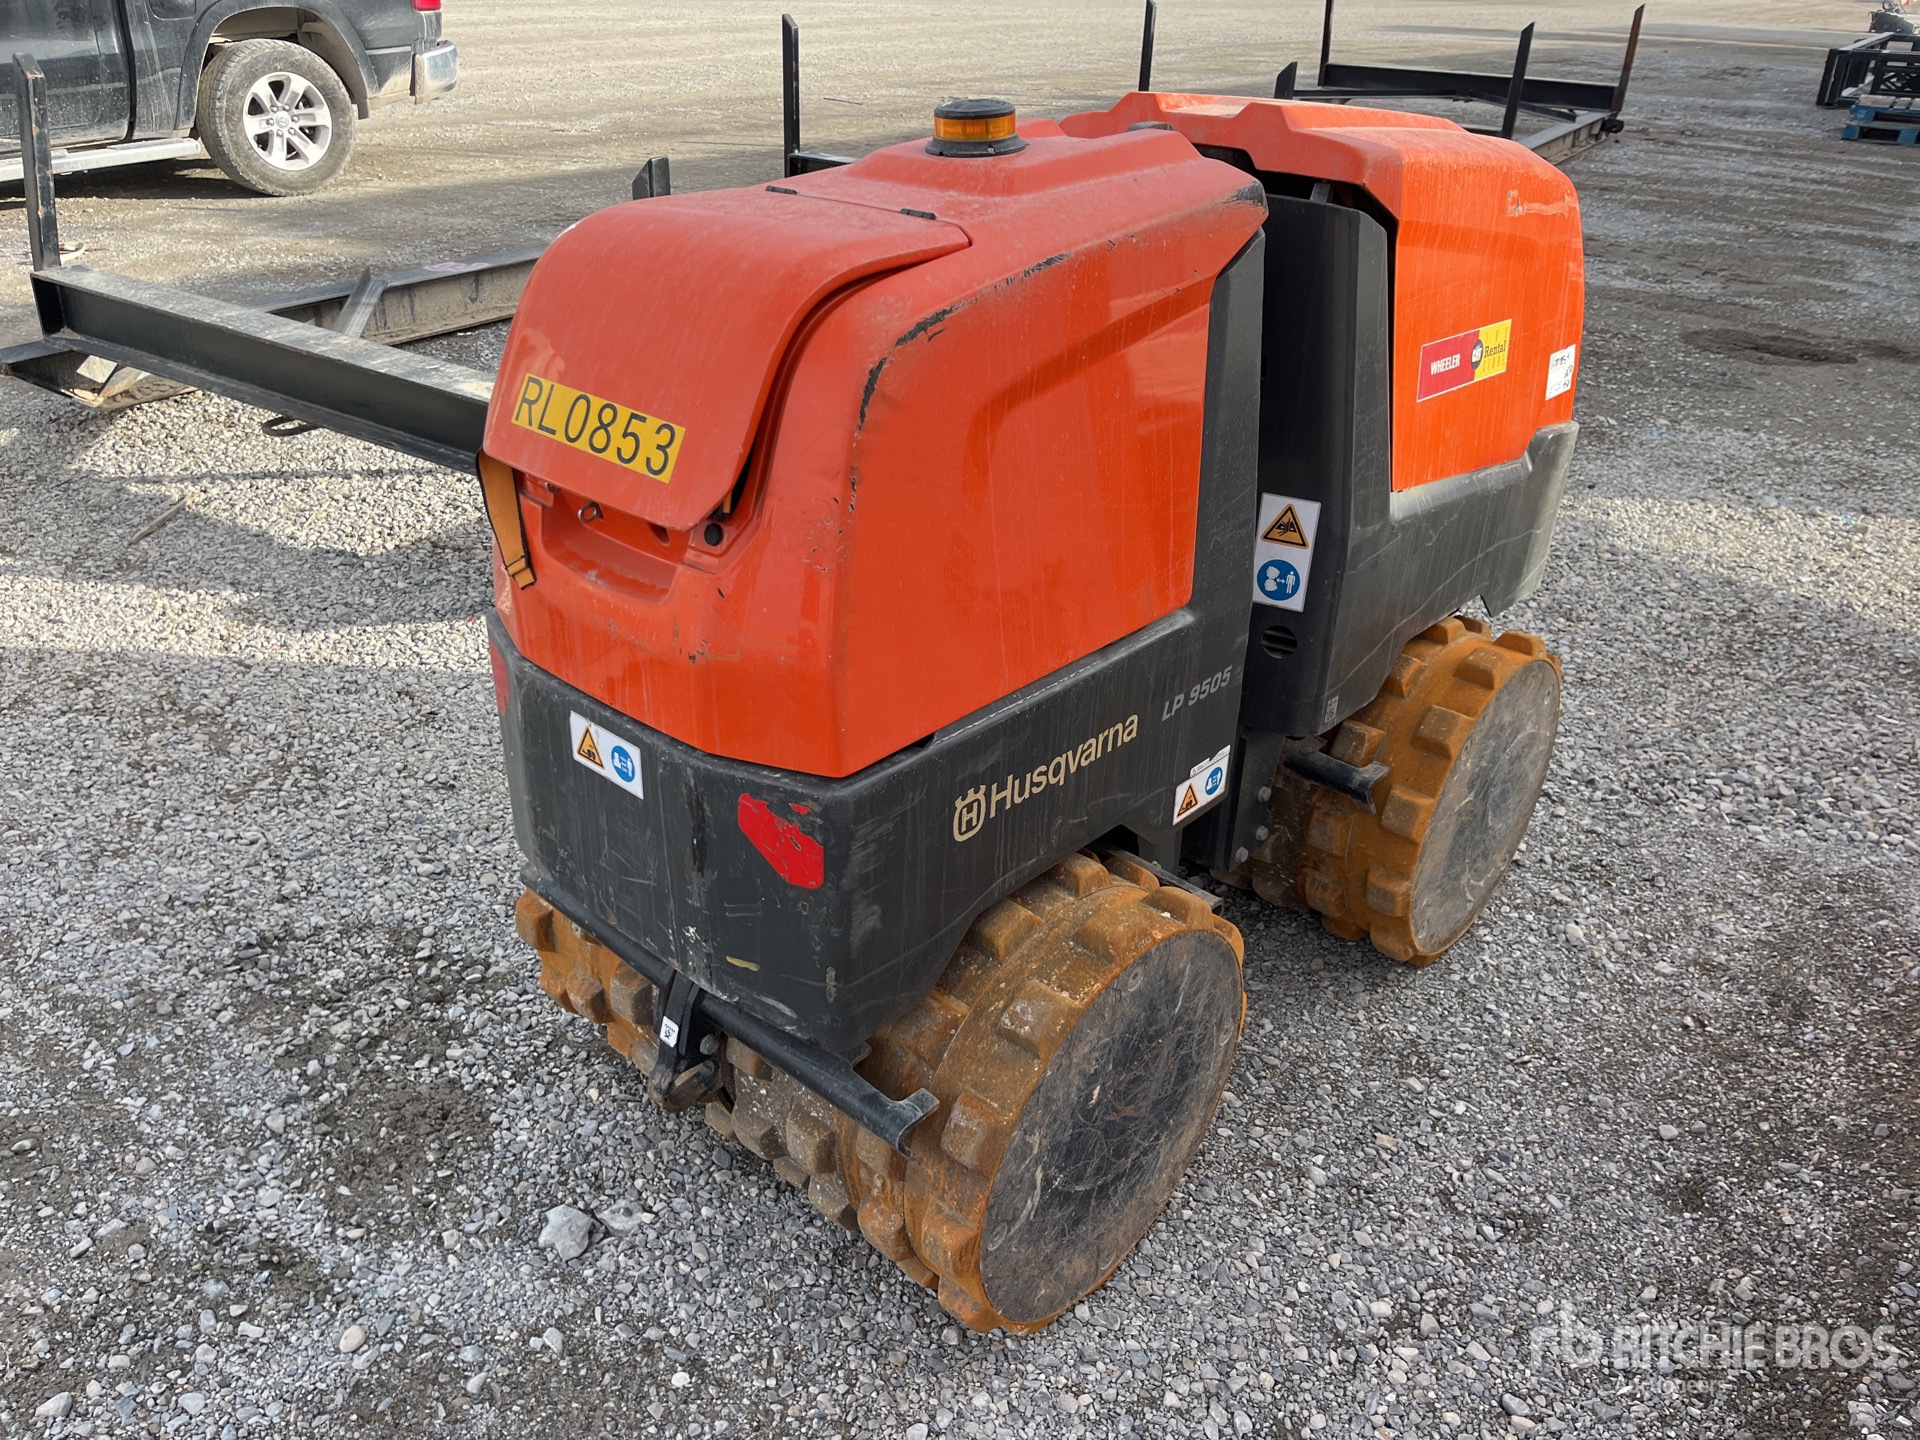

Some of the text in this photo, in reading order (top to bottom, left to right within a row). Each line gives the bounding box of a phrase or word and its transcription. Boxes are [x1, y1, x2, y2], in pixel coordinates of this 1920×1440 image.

[1430, 354, 1461, 376] WHEELER
[1484, 340, 1507, 358] Rental
[515, 376, 676, 476] RL0853
[1161, 664, 1233, 722] LP 9505
[990, 713, 1139, 819] Husqvarna
